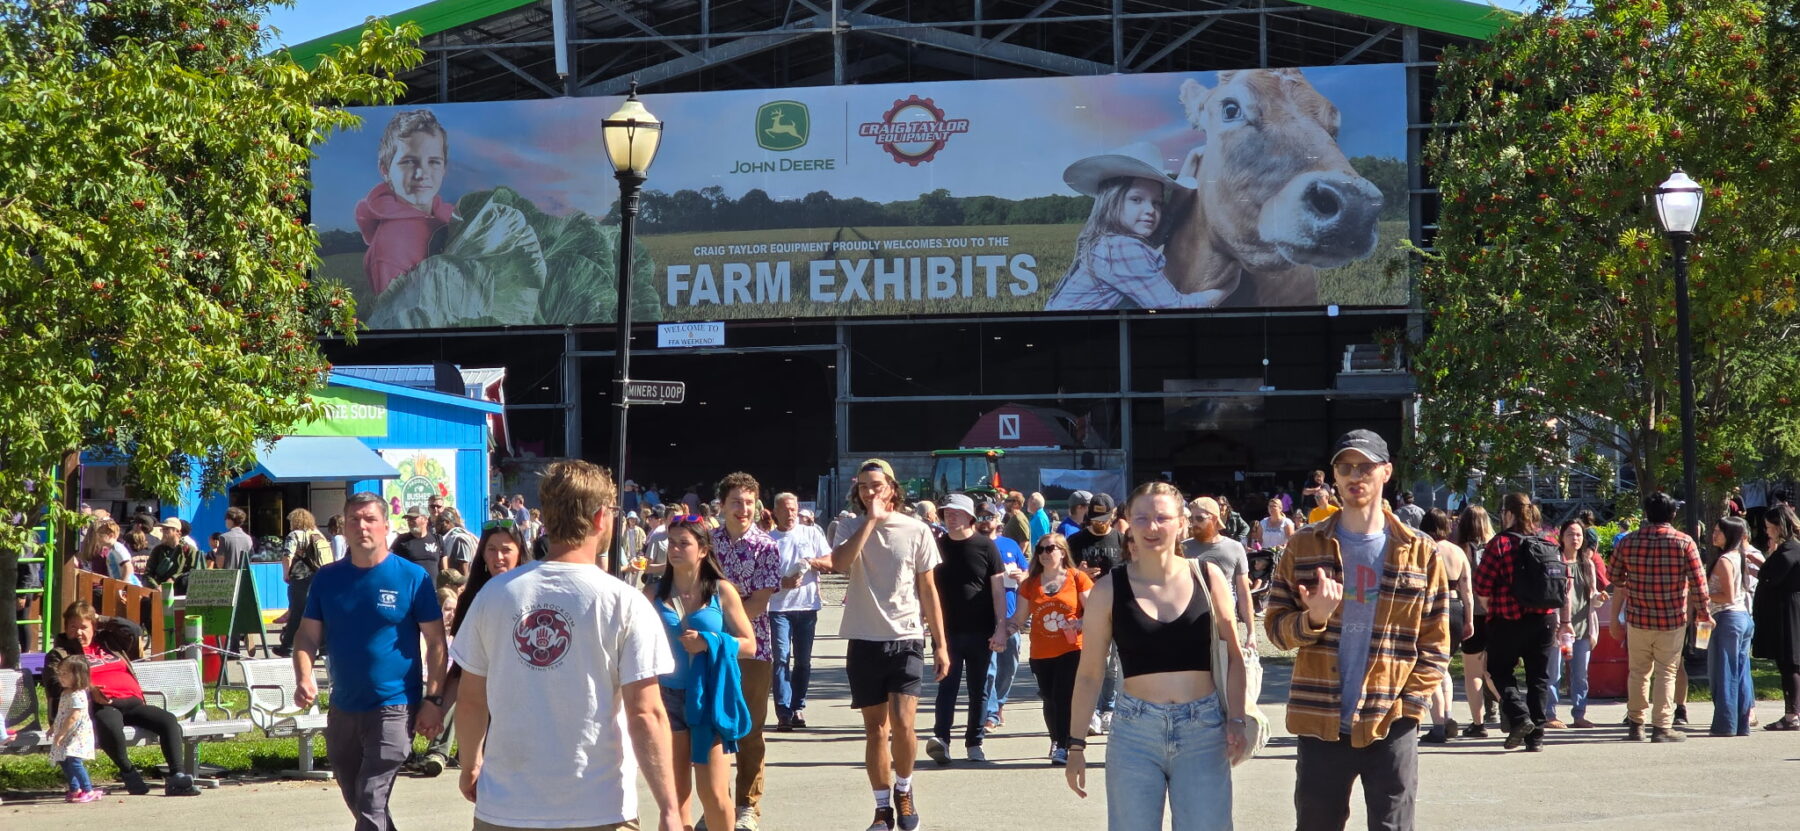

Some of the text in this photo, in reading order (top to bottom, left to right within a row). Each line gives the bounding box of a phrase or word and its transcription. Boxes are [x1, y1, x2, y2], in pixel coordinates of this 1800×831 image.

[860, 119, 968, 136] CRAIG TAYLOR
[877, 131, 950, 144] EQUIPMENT
[729, 158, 835, 174] JOHN DEERE
[693, 236, 1009, 256] CRAIG TAYLOR EQUIPMENT PROUDLY WELCOMES YOU TO THE
[667, 253, 1039, 307] FARM EXHIBITS
[663, 324, 719, 334] WELCOME TO
[628, 384, 682, 398] MINERS LOOP
[350, 404, 385, 419] SOUP
